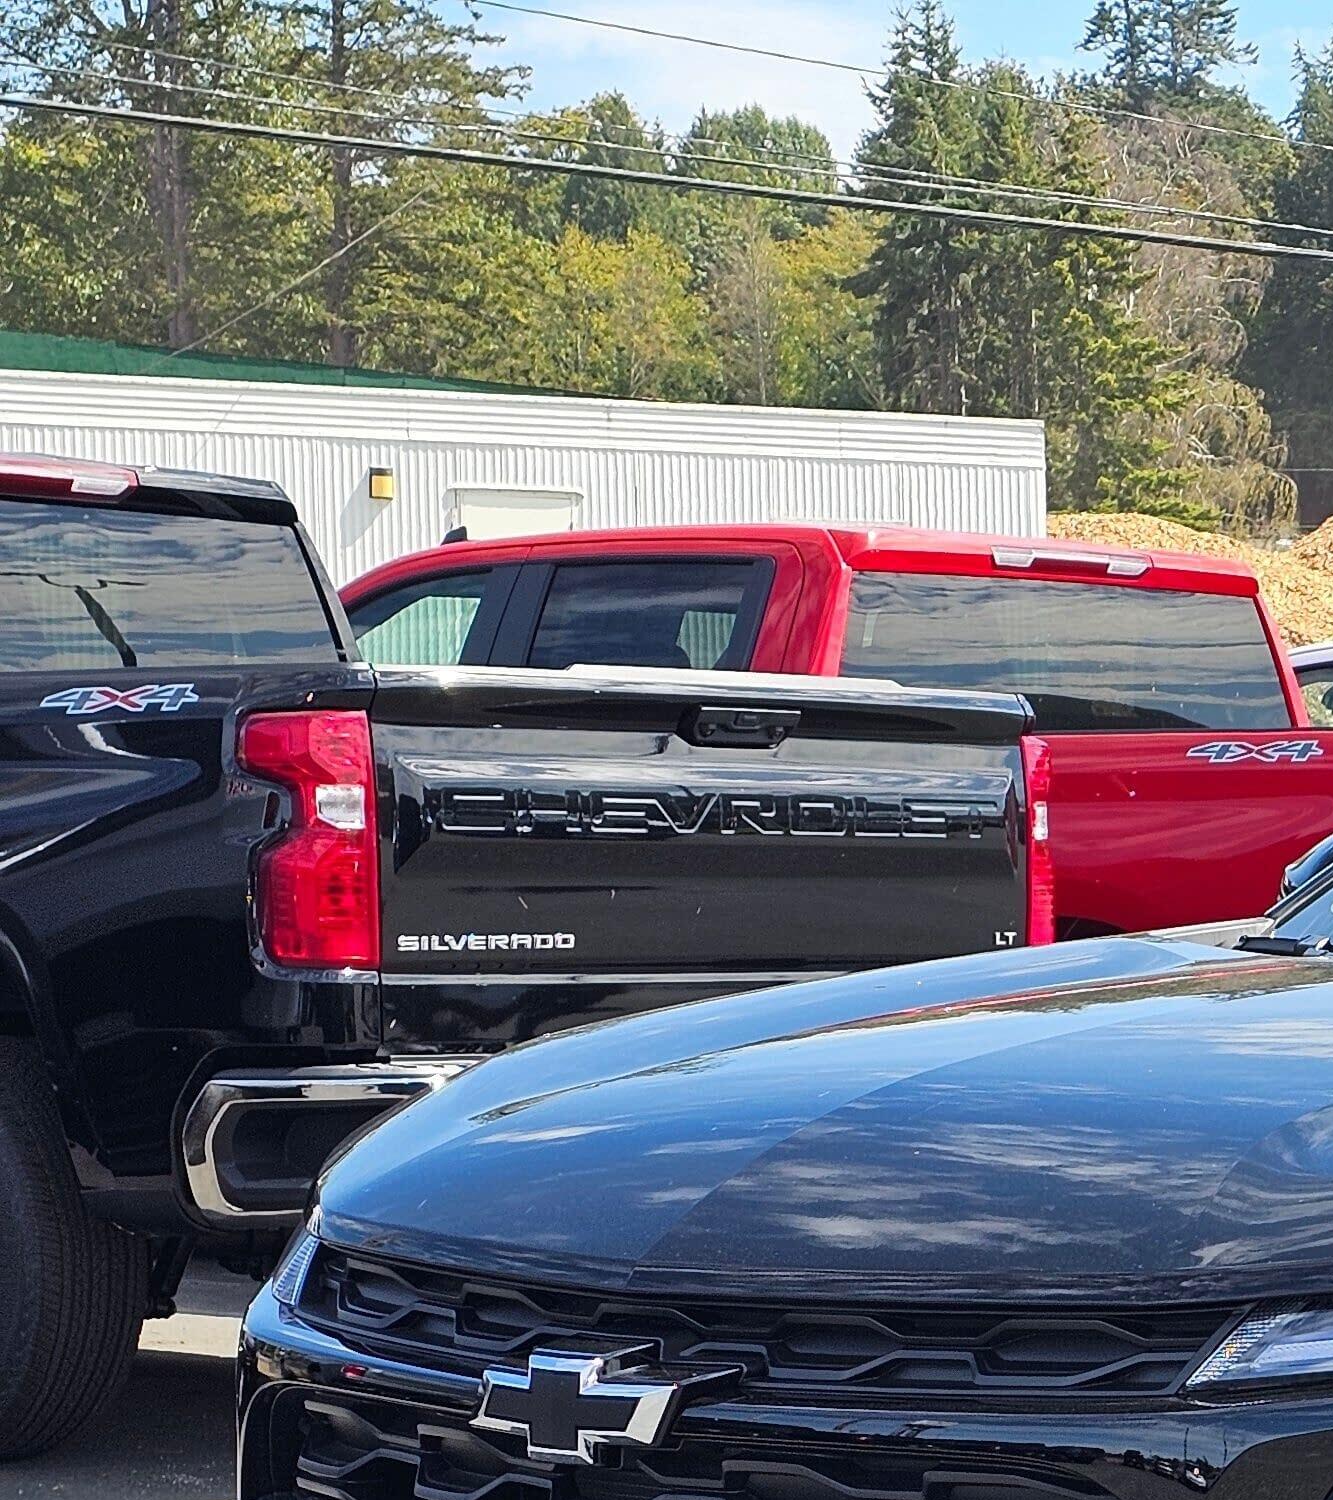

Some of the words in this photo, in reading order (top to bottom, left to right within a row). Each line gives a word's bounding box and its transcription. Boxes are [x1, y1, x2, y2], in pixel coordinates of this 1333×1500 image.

[440, 785, 998, 840] CHEVROLET
[397, 933, 576, 952] SILVERADO
[994, 930, 1018, 946] LT
